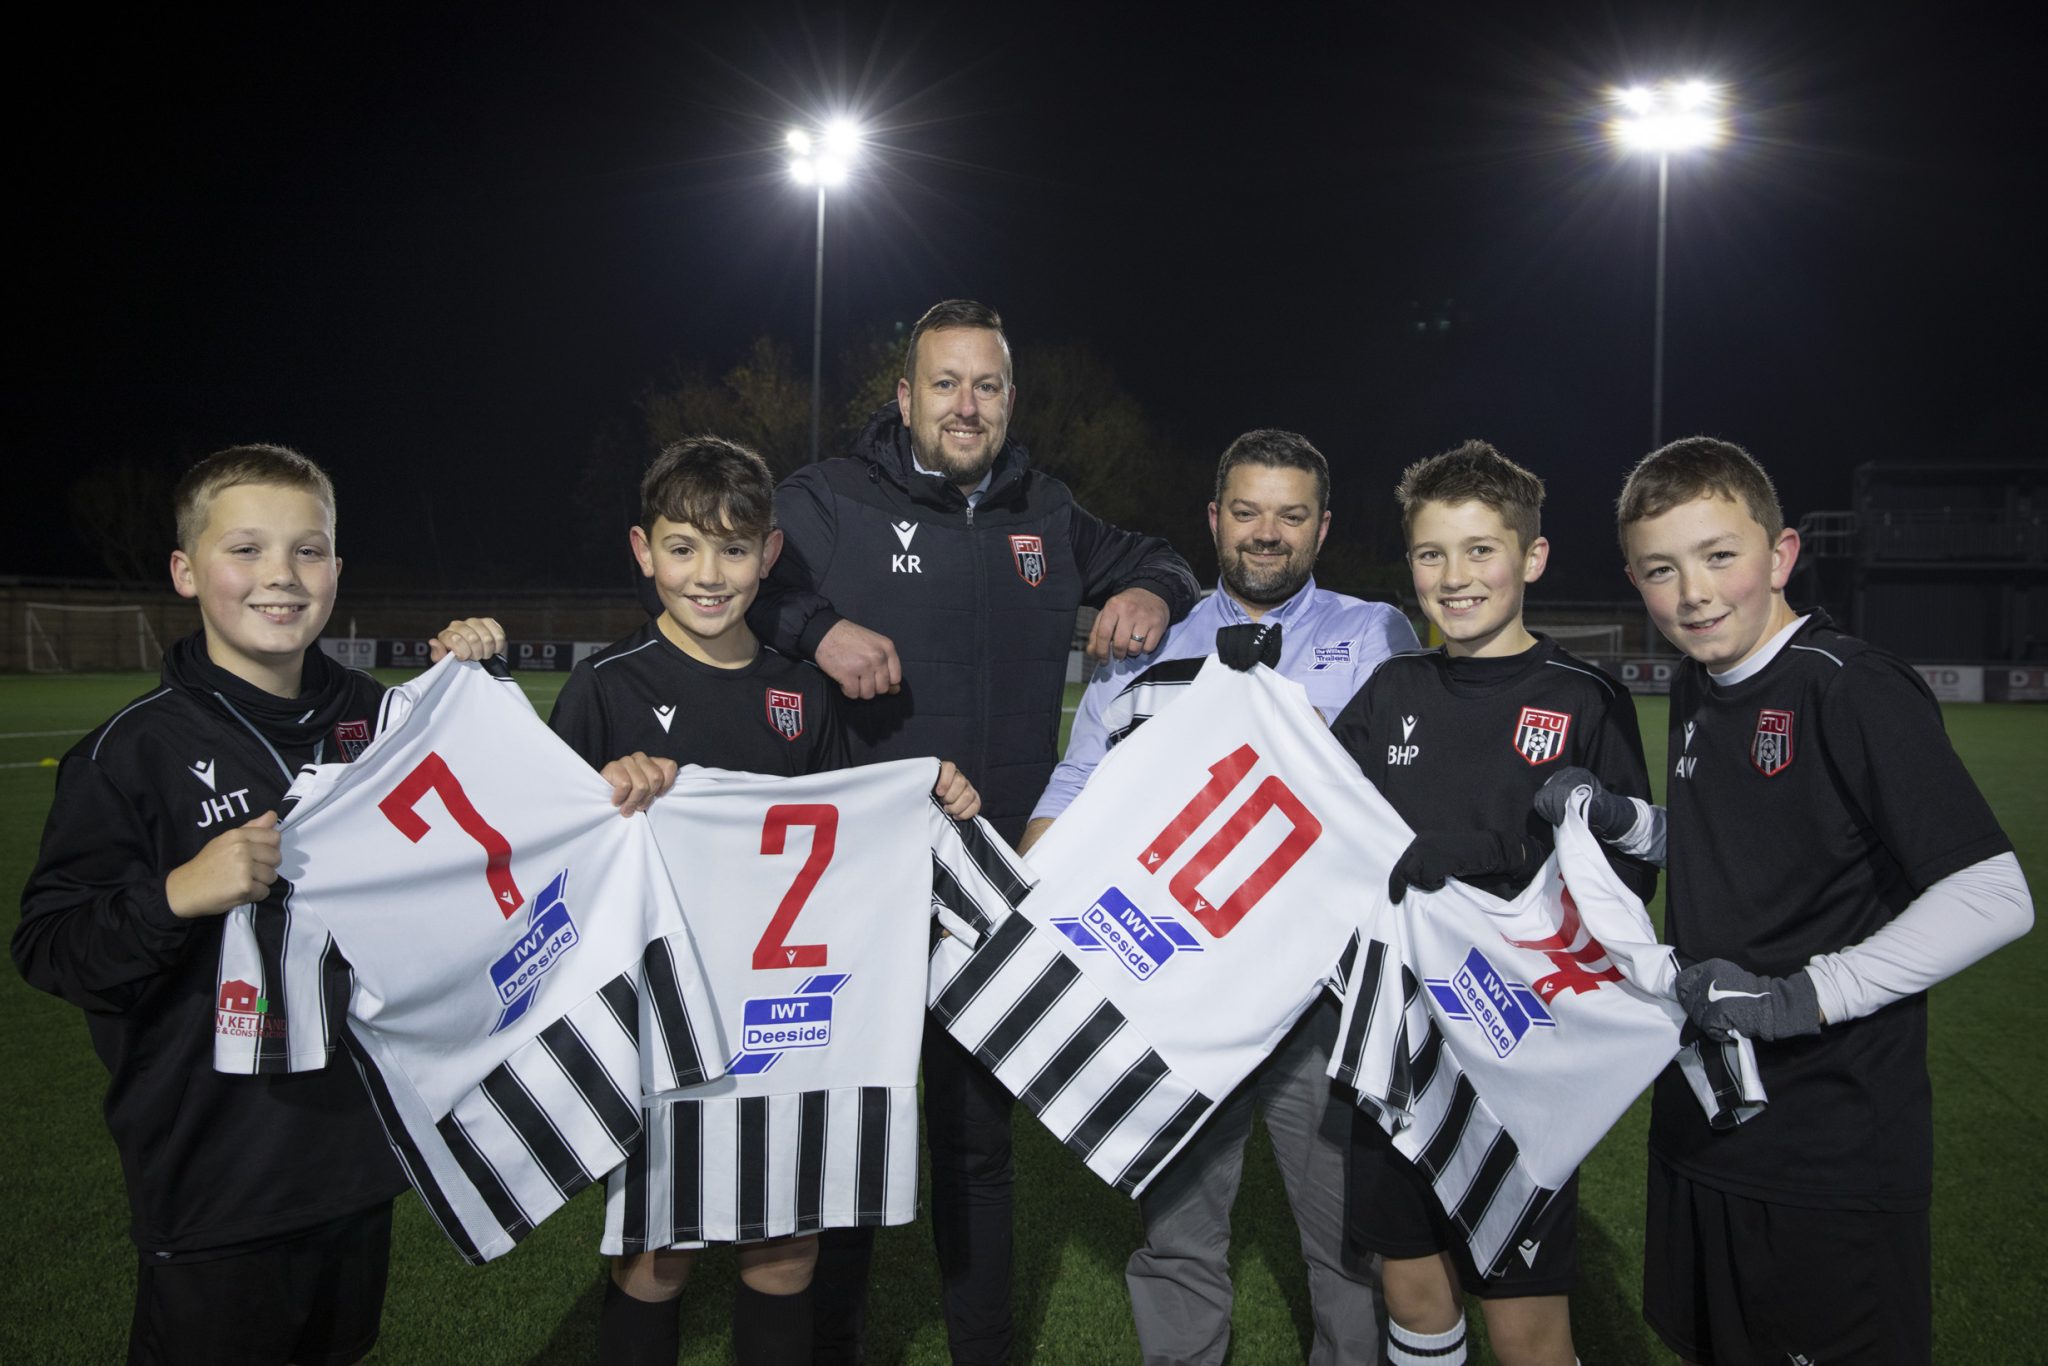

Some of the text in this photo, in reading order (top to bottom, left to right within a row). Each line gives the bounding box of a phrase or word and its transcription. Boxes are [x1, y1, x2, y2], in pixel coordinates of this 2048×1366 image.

[1016, 540, 1039, 552] FTU
[892, 554, 922, 573] KR
[771, 695, 798, 708] FTU
[338, 726, 364, 738] FTU
[1525, 714, 1563, 731] FTU
[1760, 717, 1785, 732] FTU
[1388, 745, 1419, 765] BHP
[1675, 756, 1697, 779] AW
[197, 788, 250, 827] JHT
[378, 751, 525, 920] 7
[1137, 743, 1322, 939] 10
[752, 804, 839, 970] 2
[1120, 907, 1154, 942] IWT
[513, 923, 545, 963] IWT
[1088, 908, 1150, 974] Deeside
[503, 931, 573, 998] Deeside
[1483, 972, 1513, 1011] IWT
[771, 1002, 809, 1019] IWT
[1458, 971, 1510, 1051] Deeside
[747, 1026, 828, 1044] Deeside
